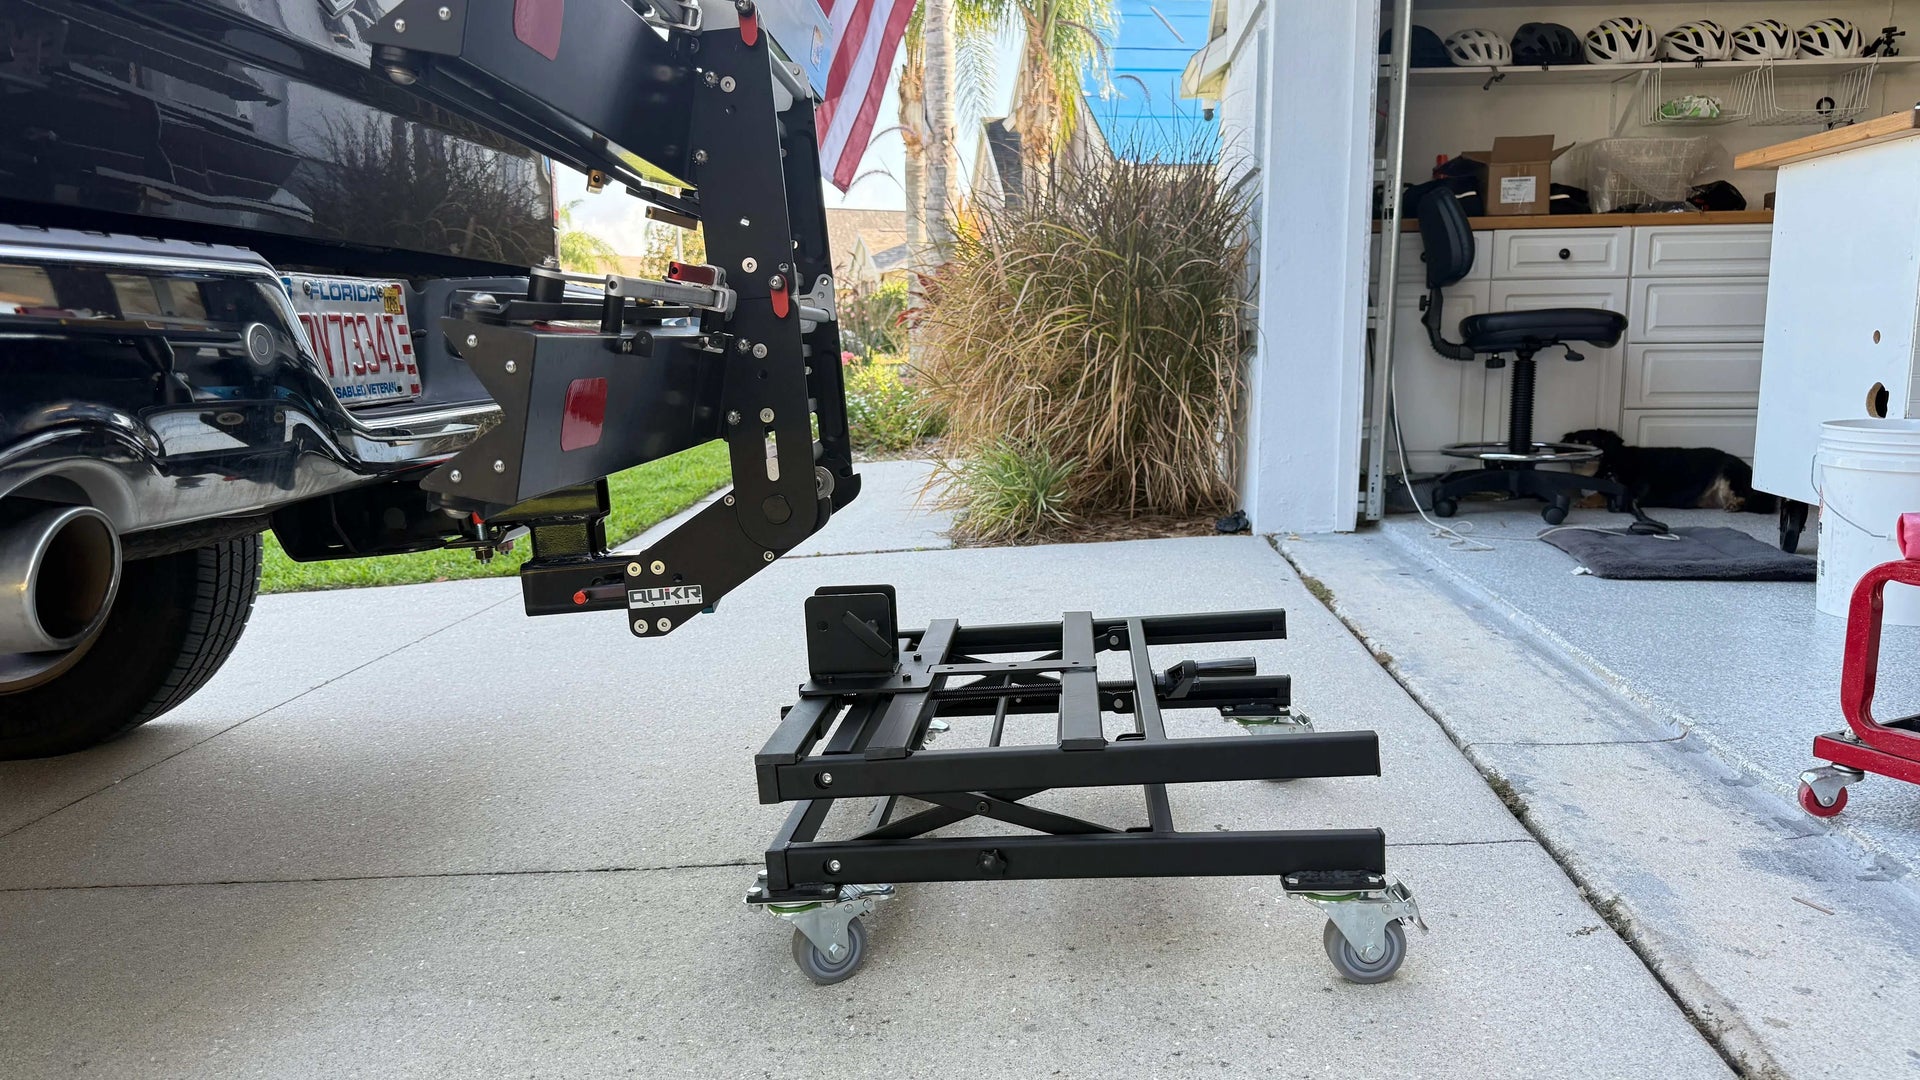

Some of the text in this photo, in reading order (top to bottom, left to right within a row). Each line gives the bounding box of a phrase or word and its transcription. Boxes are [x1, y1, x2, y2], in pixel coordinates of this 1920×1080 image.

[310, 280, 380, 302] FLORIDA
[333, 381, 397, 398] SABLED VETERAN
